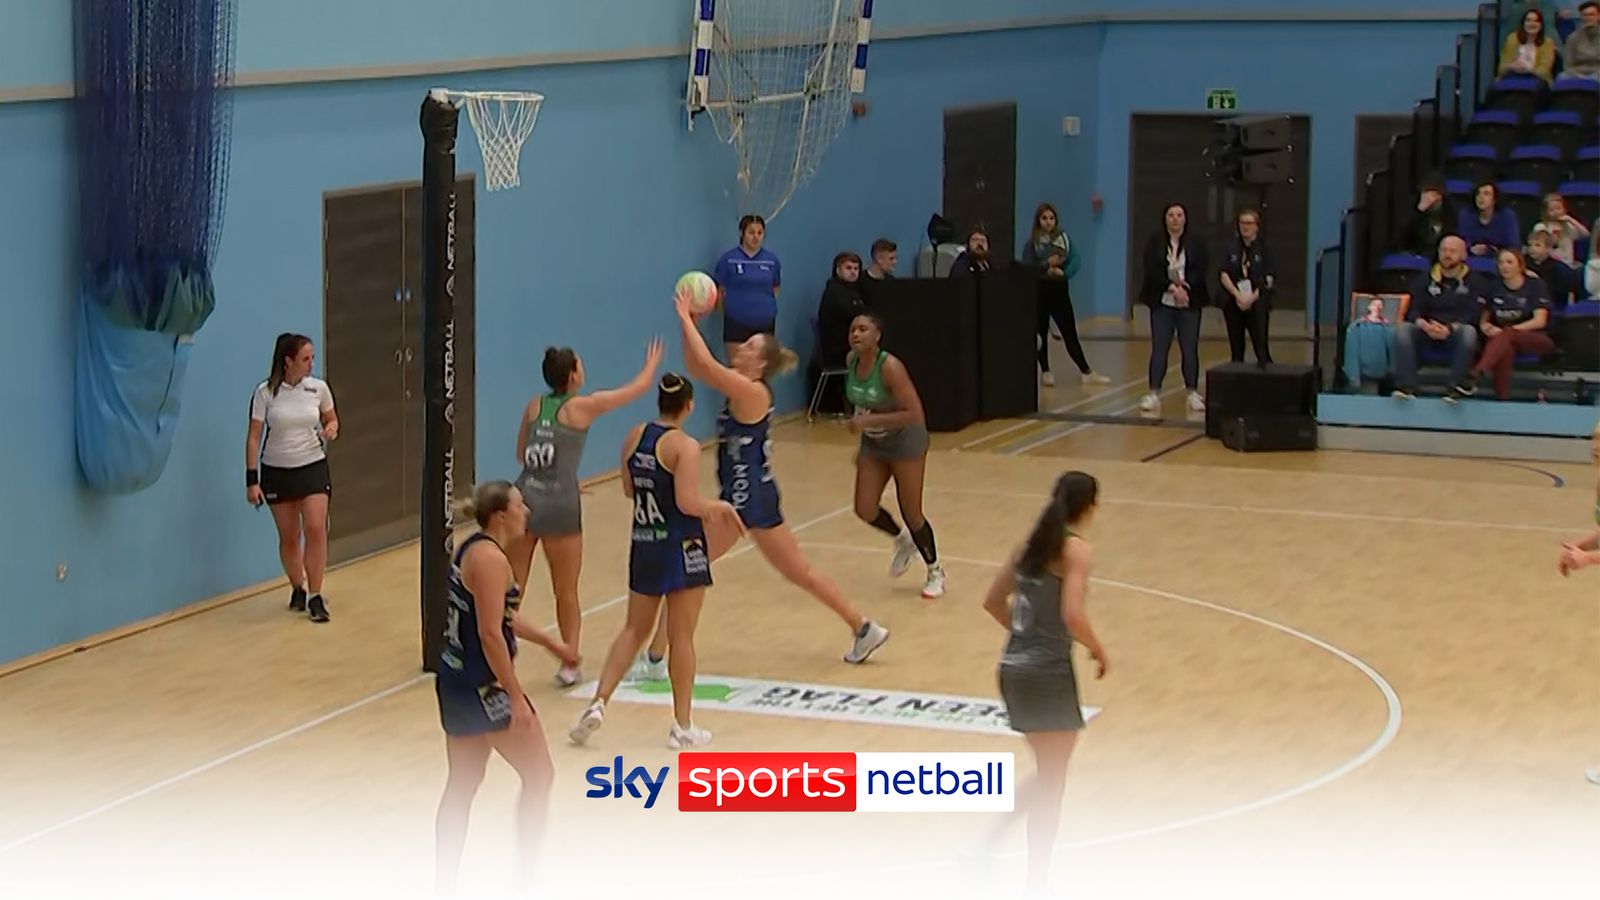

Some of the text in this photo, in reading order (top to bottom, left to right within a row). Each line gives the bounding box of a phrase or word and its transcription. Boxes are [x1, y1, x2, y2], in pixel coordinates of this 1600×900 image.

[445, 319, 454, 399] NETBALL
[445, 448, 455, 529] NETBALL
[761, 686, 889, 706] FLAG
